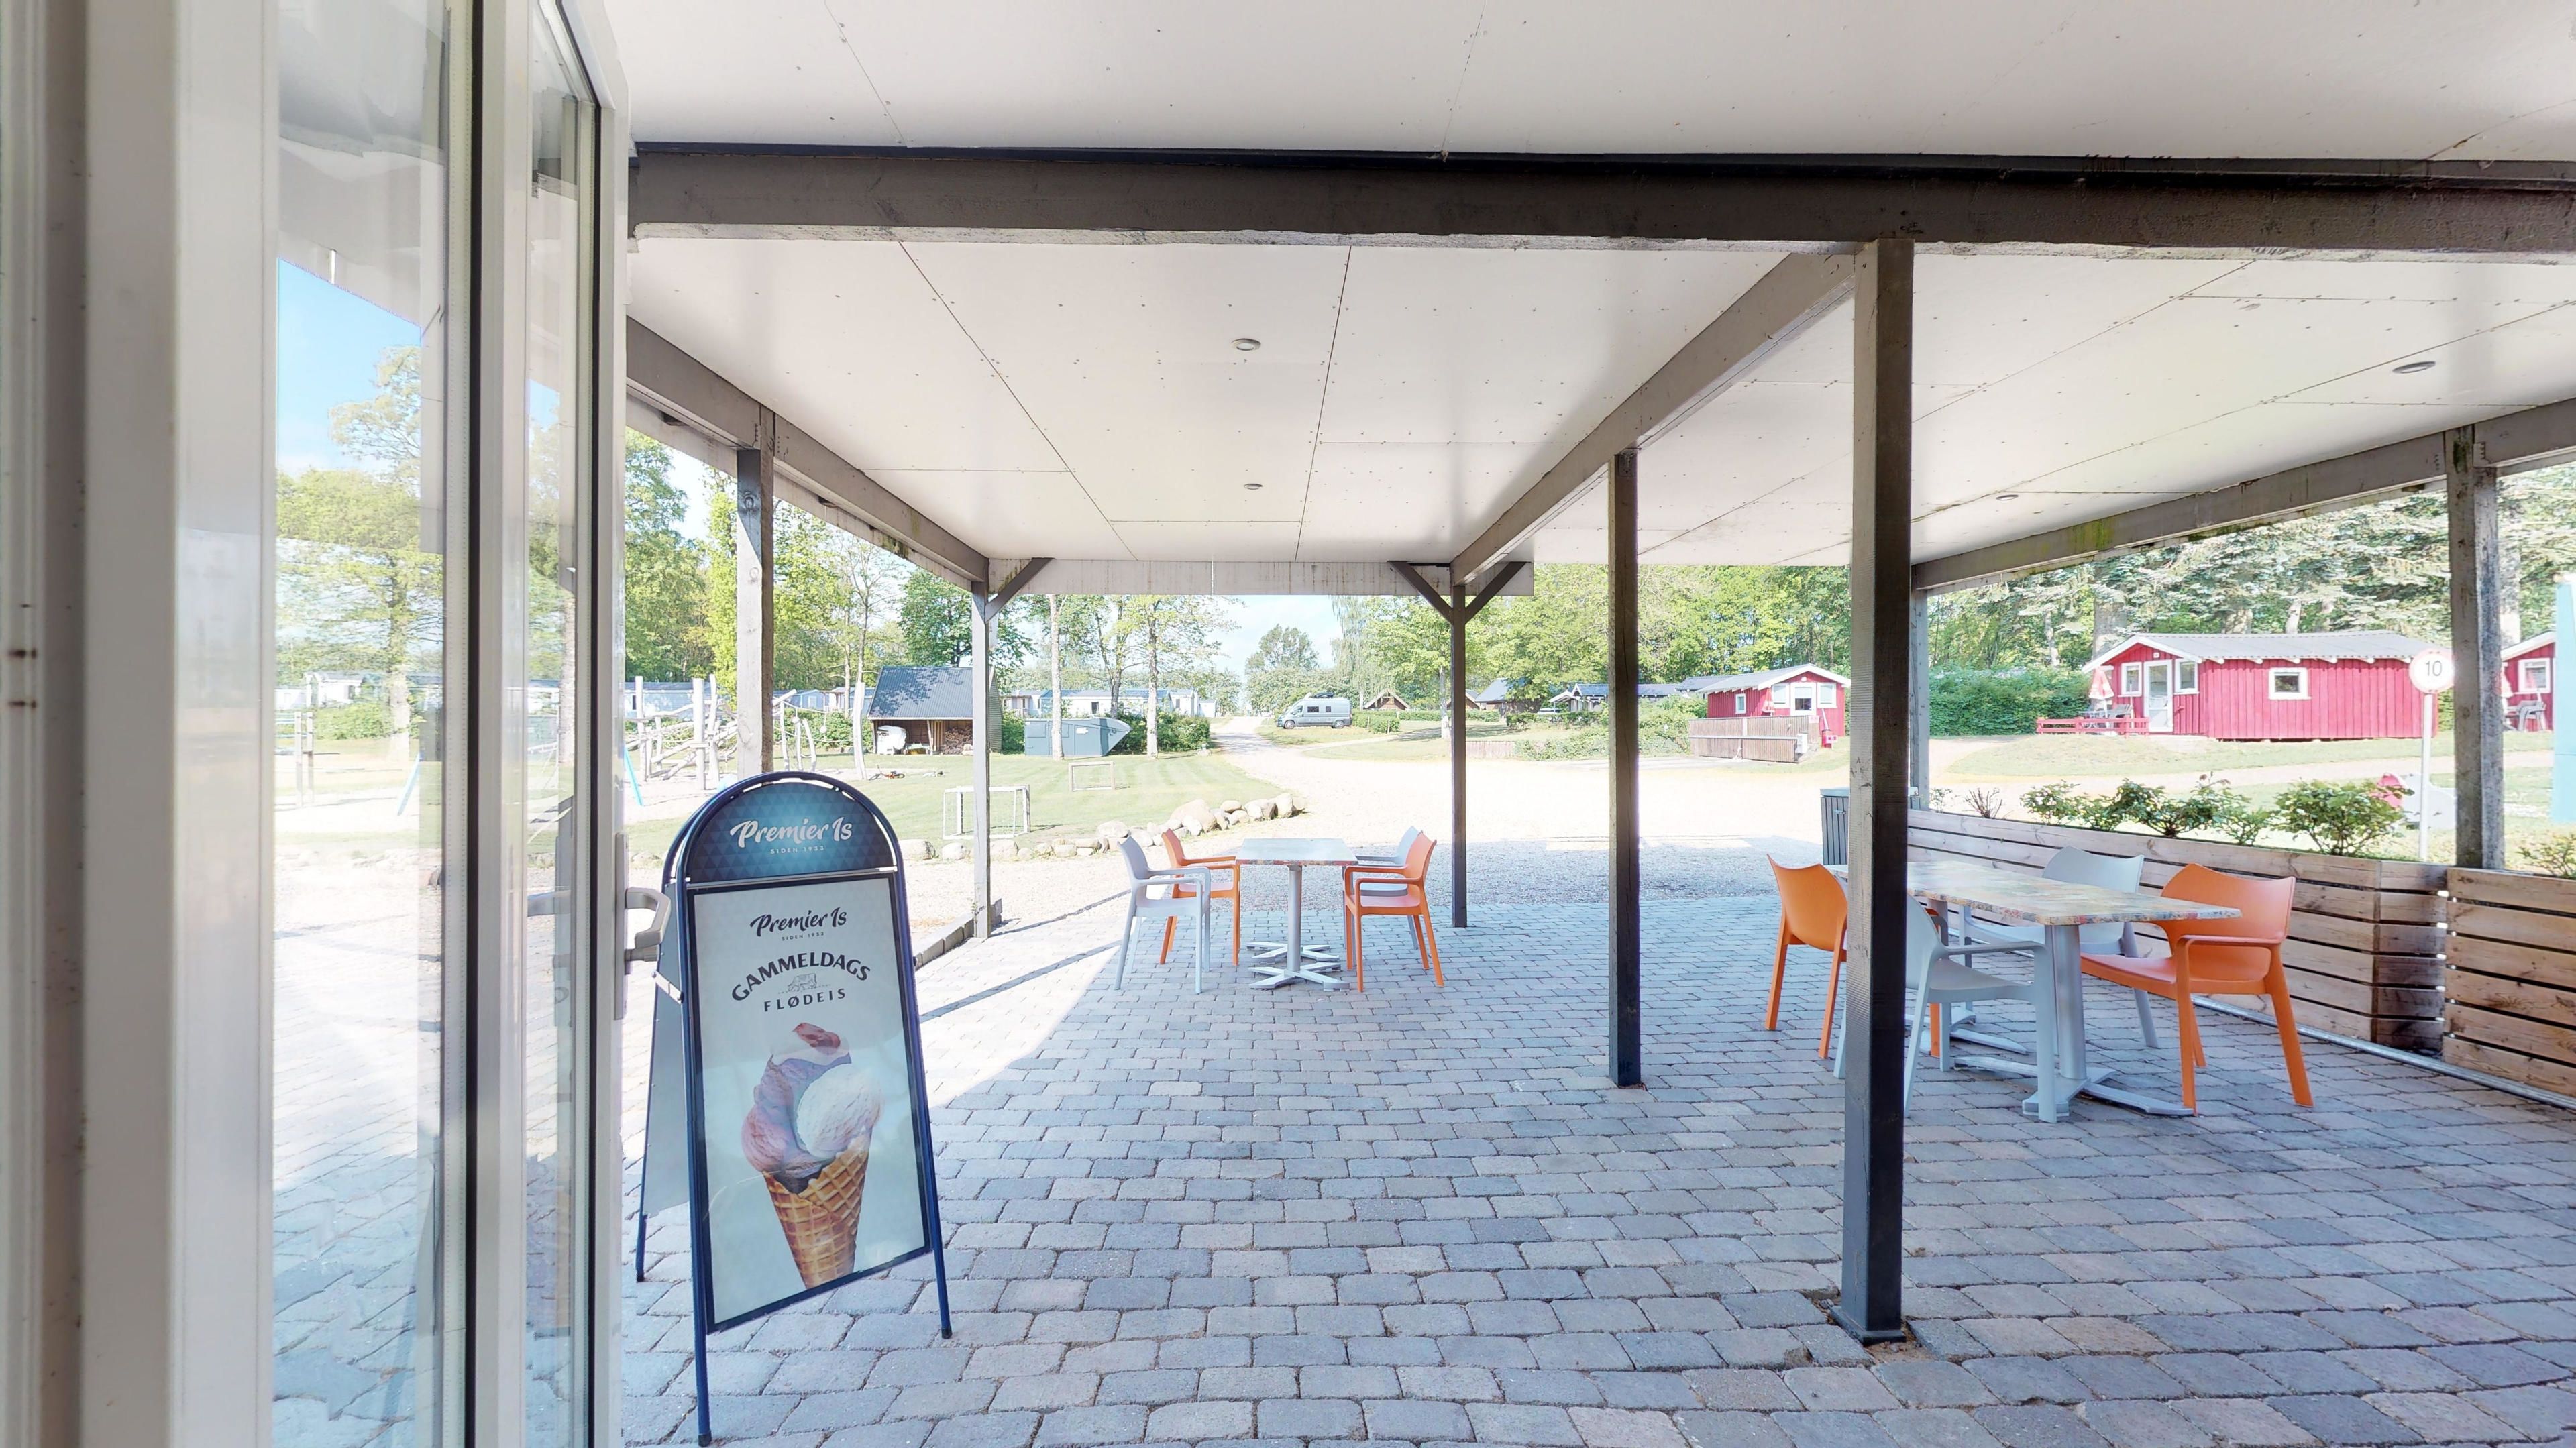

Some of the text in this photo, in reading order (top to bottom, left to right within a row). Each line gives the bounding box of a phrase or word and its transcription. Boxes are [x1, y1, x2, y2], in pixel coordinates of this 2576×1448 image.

[2425, 660, 2443, 677] 10
[729, 816, 853, 848] Premier Is
[749, 906, 847, 937] Premier Is
[731, 952, 871, 1001] GAMMELDAGS
[763, 988, 846, 1012] FLØDEIS
